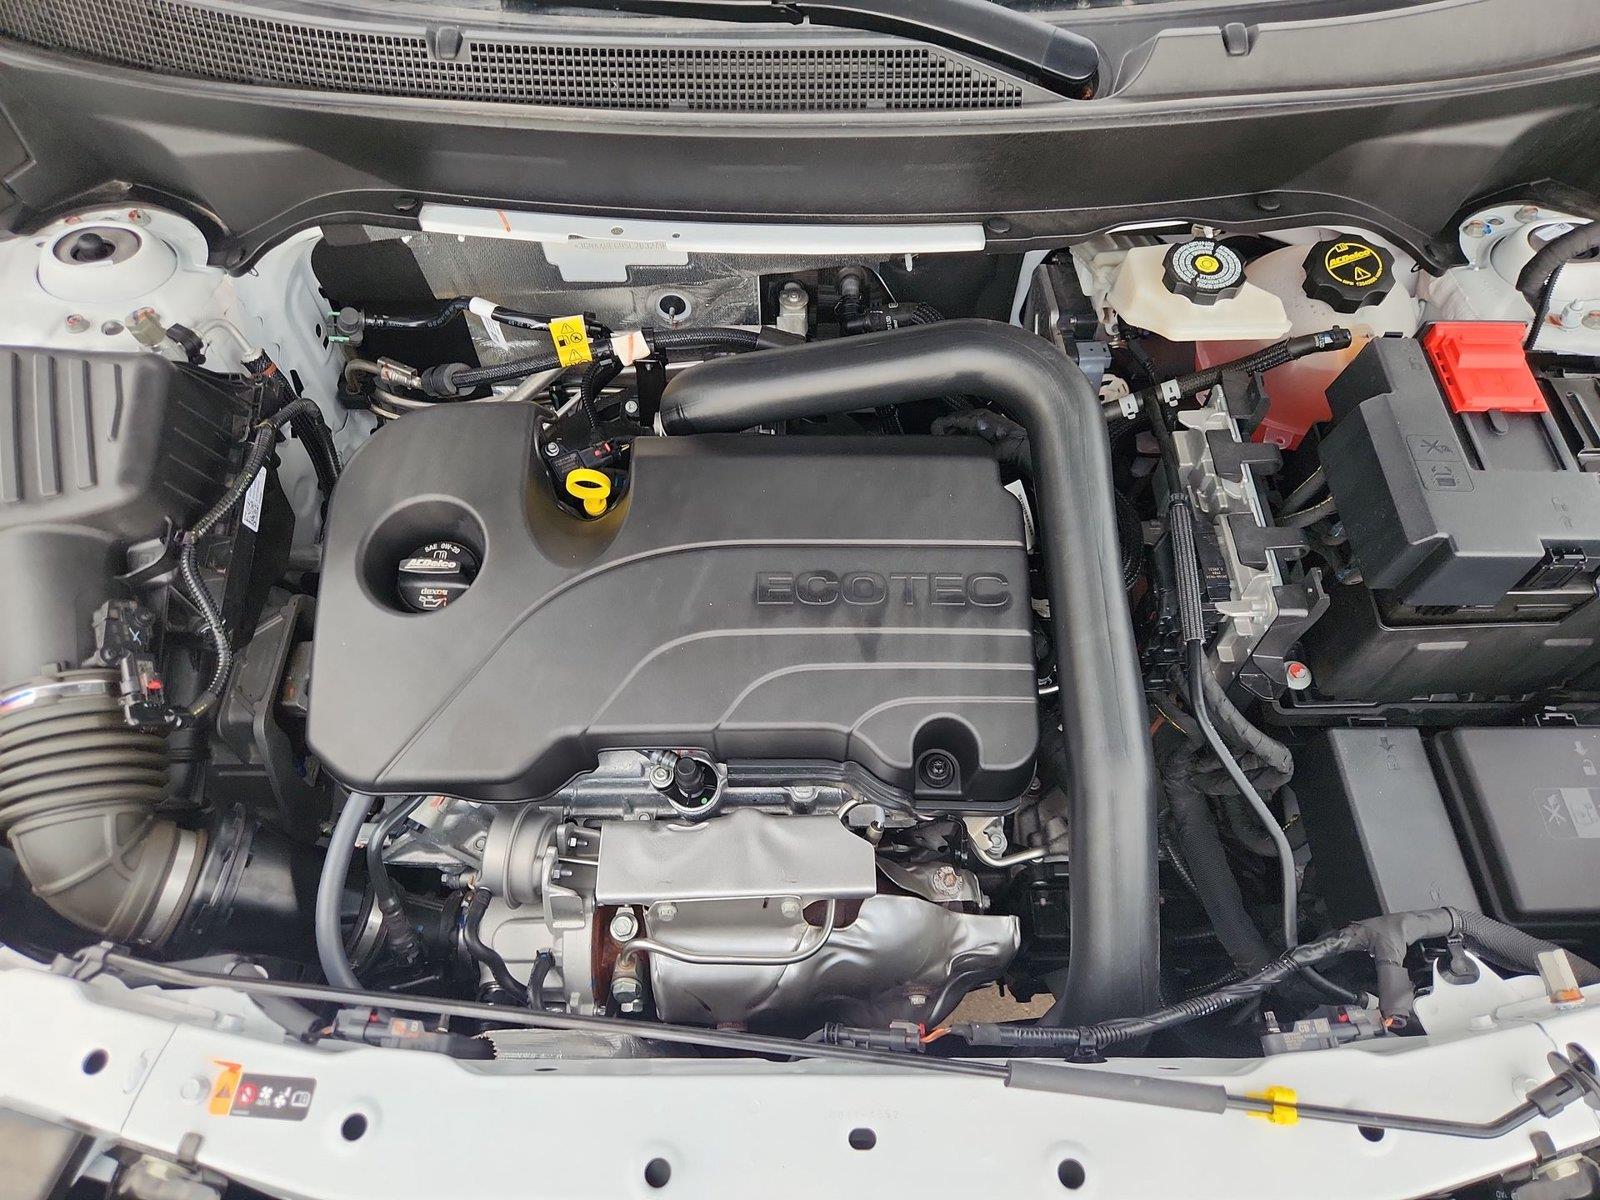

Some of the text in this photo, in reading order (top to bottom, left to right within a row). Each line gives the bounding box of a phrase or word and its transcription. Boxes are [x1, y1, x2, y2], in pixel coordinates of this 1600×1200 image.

[1329, 249, 1371, 268] ACDelco
[424, 543, 461, 554] SAE 0W-20
[404, 558, 457, 569] ACDelco
[420, 587, 449, 596] dexos
[756, 570, 1010, 607] ECOTEC
